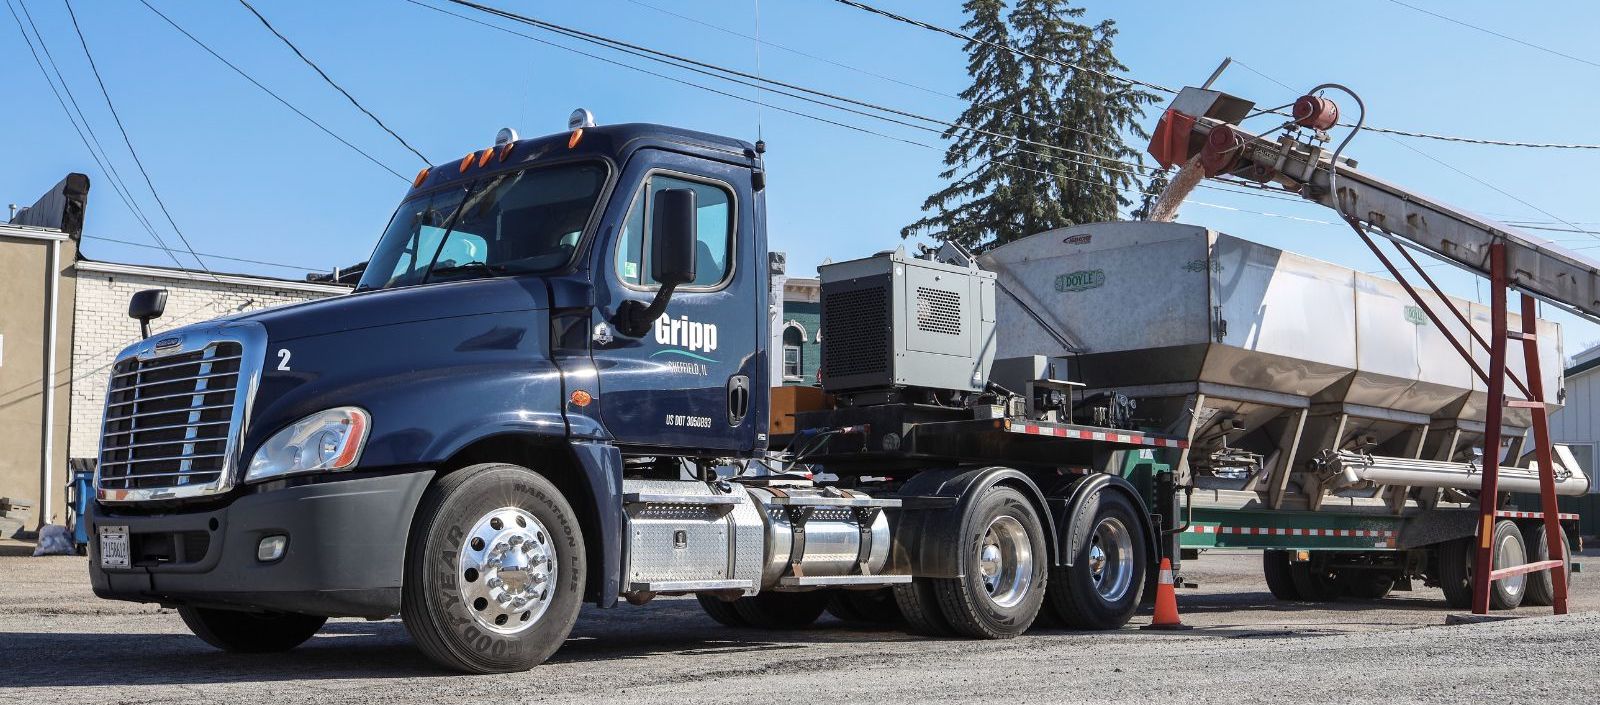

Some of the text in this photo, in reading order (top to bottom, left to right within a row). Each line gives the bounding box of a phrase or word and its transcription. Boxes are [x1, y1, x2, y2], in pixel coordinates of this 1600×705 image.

[1066, 272, 1094, 287] DOYLE
[655, 312, 717, 353] Gripp
[277, 348, 291, 371] 2
[666, 414, 674, 425] US
[675, 415, 686, 426] DOT
[513, 483, 576, 548] MARATHON
